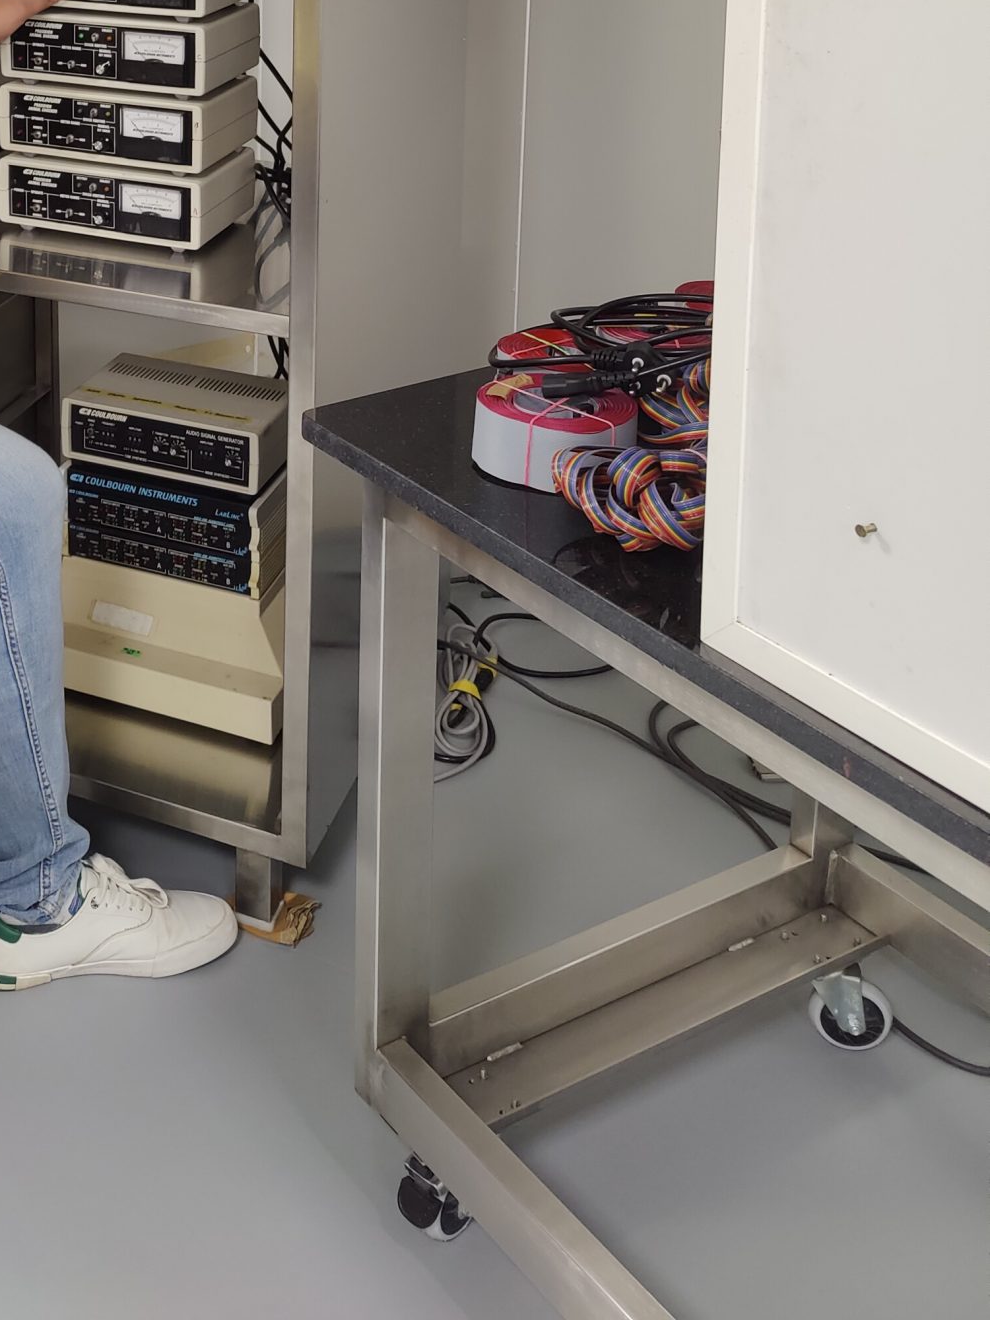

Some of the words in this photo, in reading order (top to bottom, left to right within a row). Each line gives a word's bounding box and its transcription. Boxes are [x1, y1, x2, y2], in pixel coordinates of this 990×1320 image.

[91, 409, 128, 422] COULBOURN
[85, 476, 137, 494] COULBOURN
[138, 487, 199, 507] INSTRUMENTS
